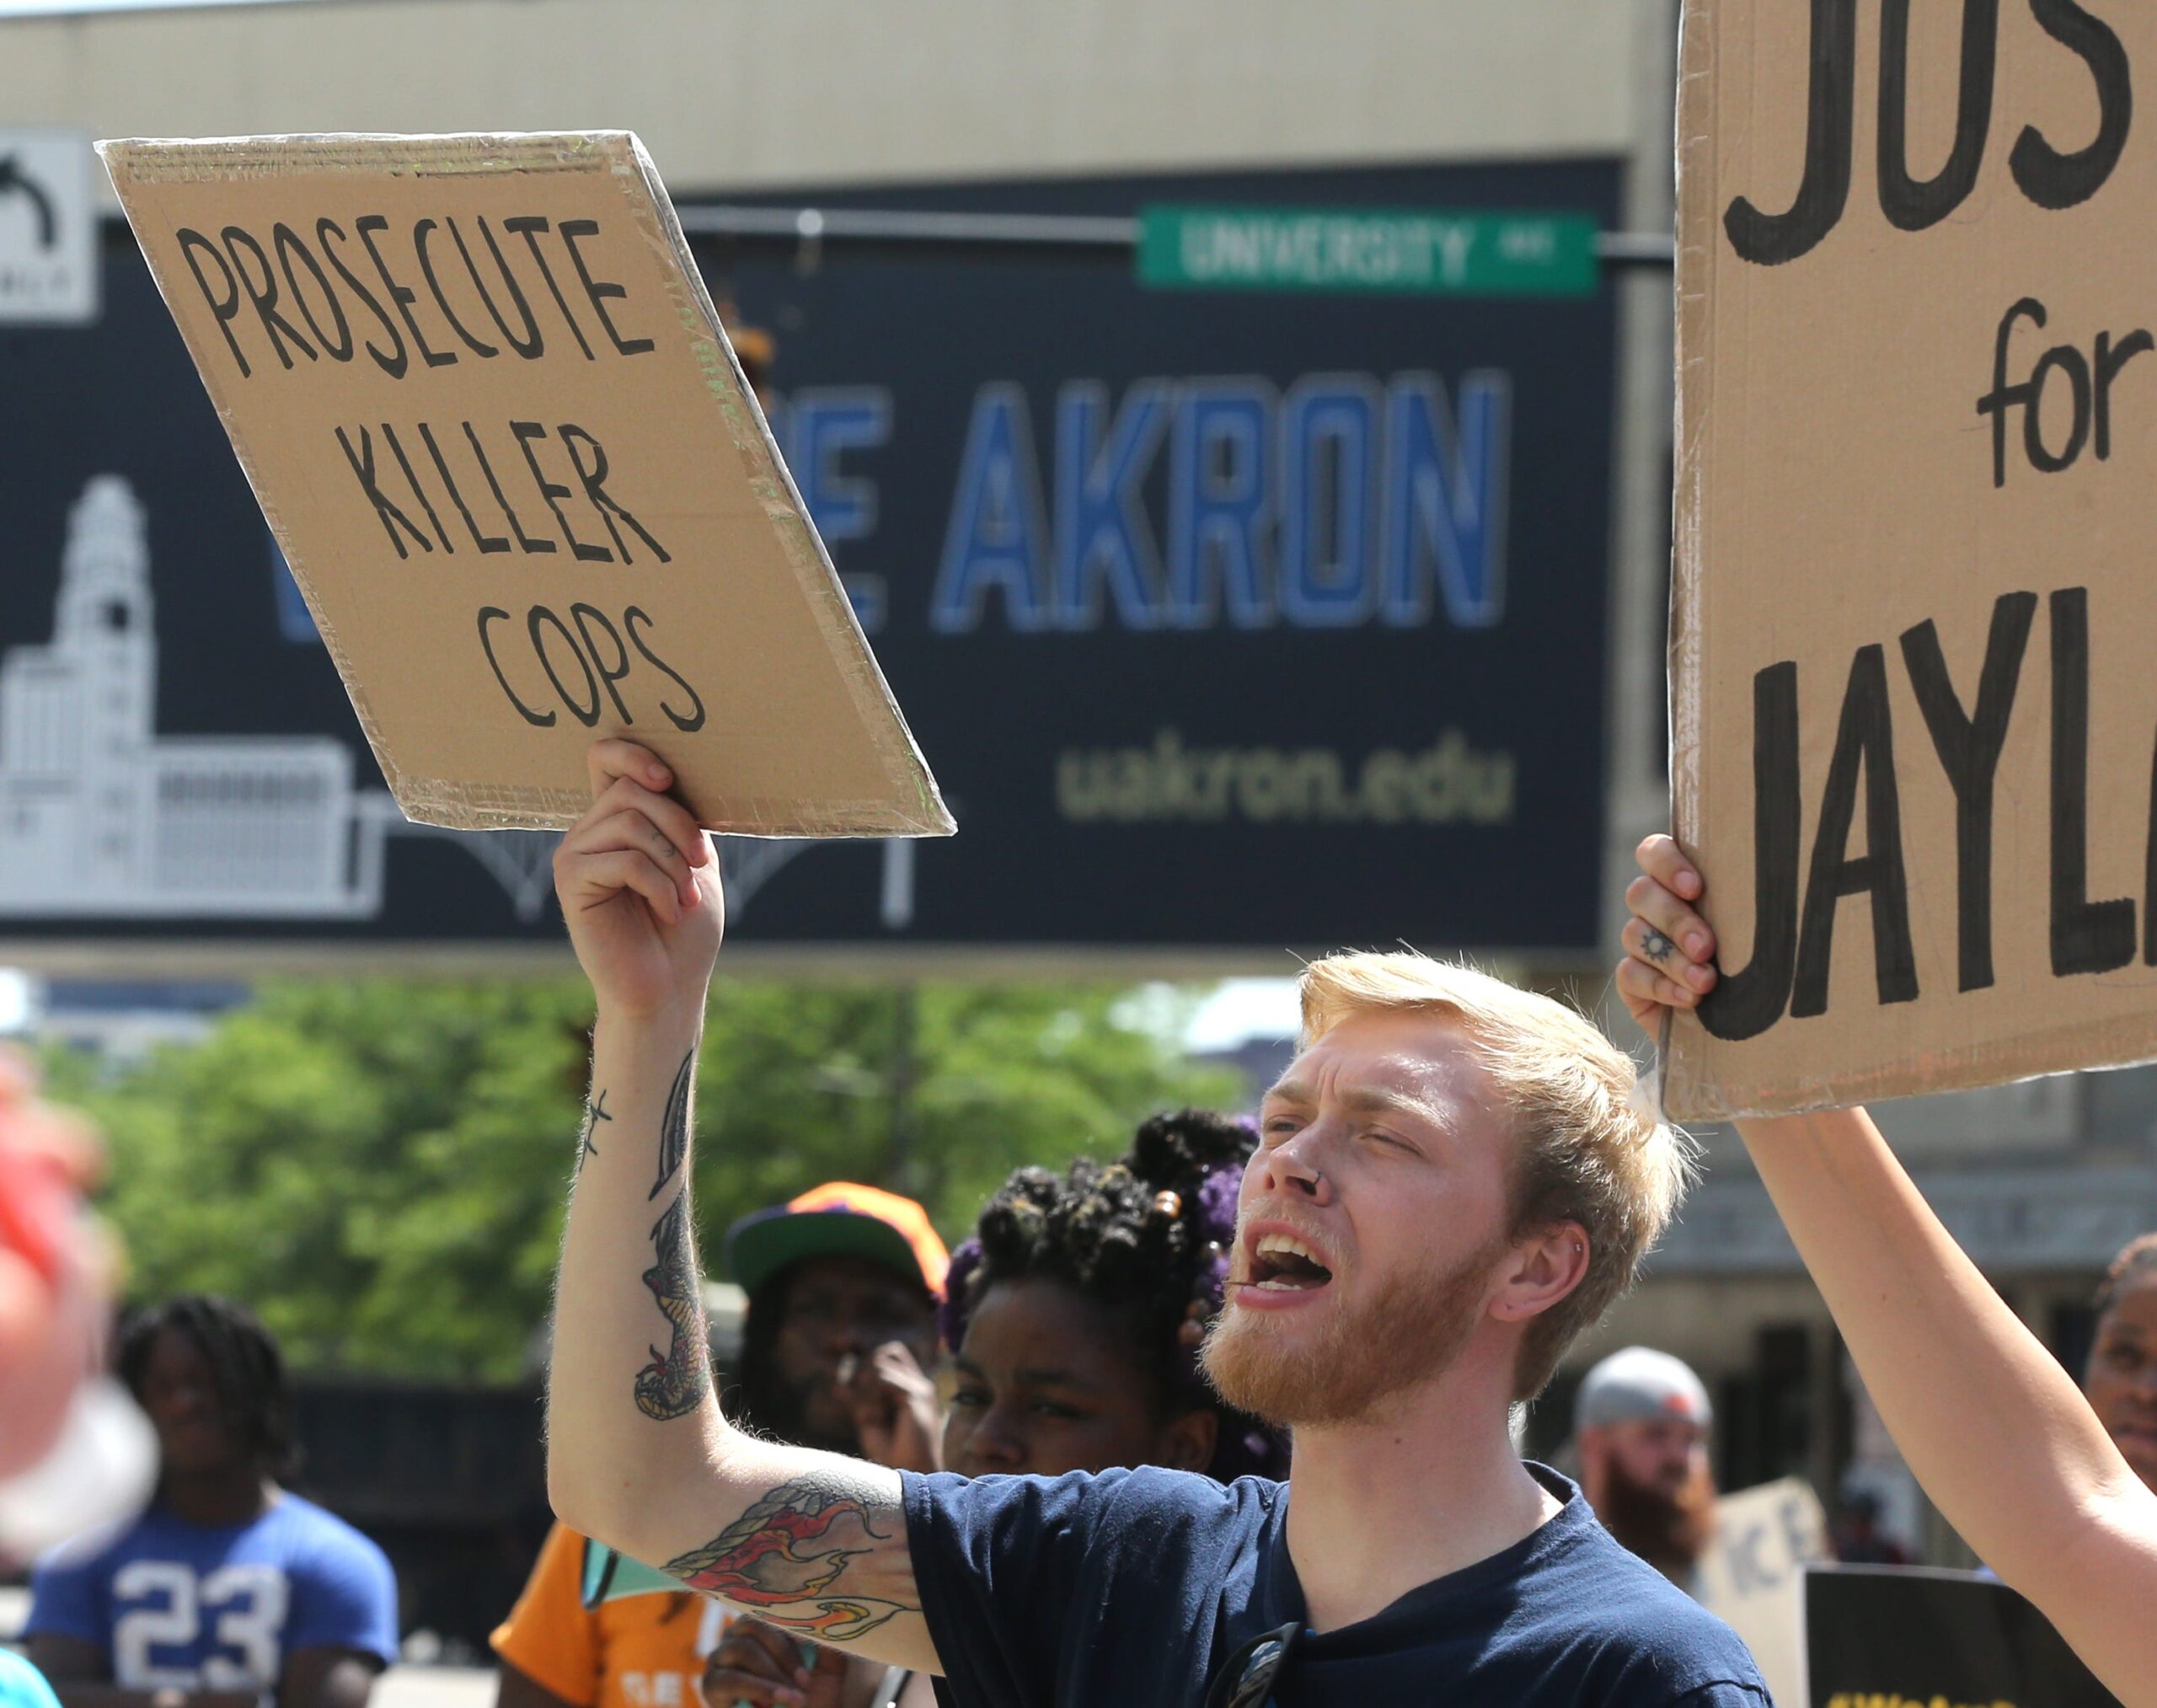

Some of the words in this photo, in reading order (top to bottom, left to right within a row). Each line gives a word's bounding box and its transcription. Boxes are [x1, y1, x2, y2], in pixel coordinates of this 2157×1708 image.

[1723, 0, 2133, 267] JUS
[175, 214, 656, 380] PROSECUTE
[1180, 211, 1475, 285] UNIVERSITY
[1976, 297, 2154, 488] for
[334, 420, 672, 565] KILLER
[929, 367, 1511, 634] AKRON
[477, 602, 706, 732] COPS
[1056, 728, 1516, 823] uakron.edu
[1692, 586, 2157, 1041] JAYL
[111, 1561, 290, 1694] 23
